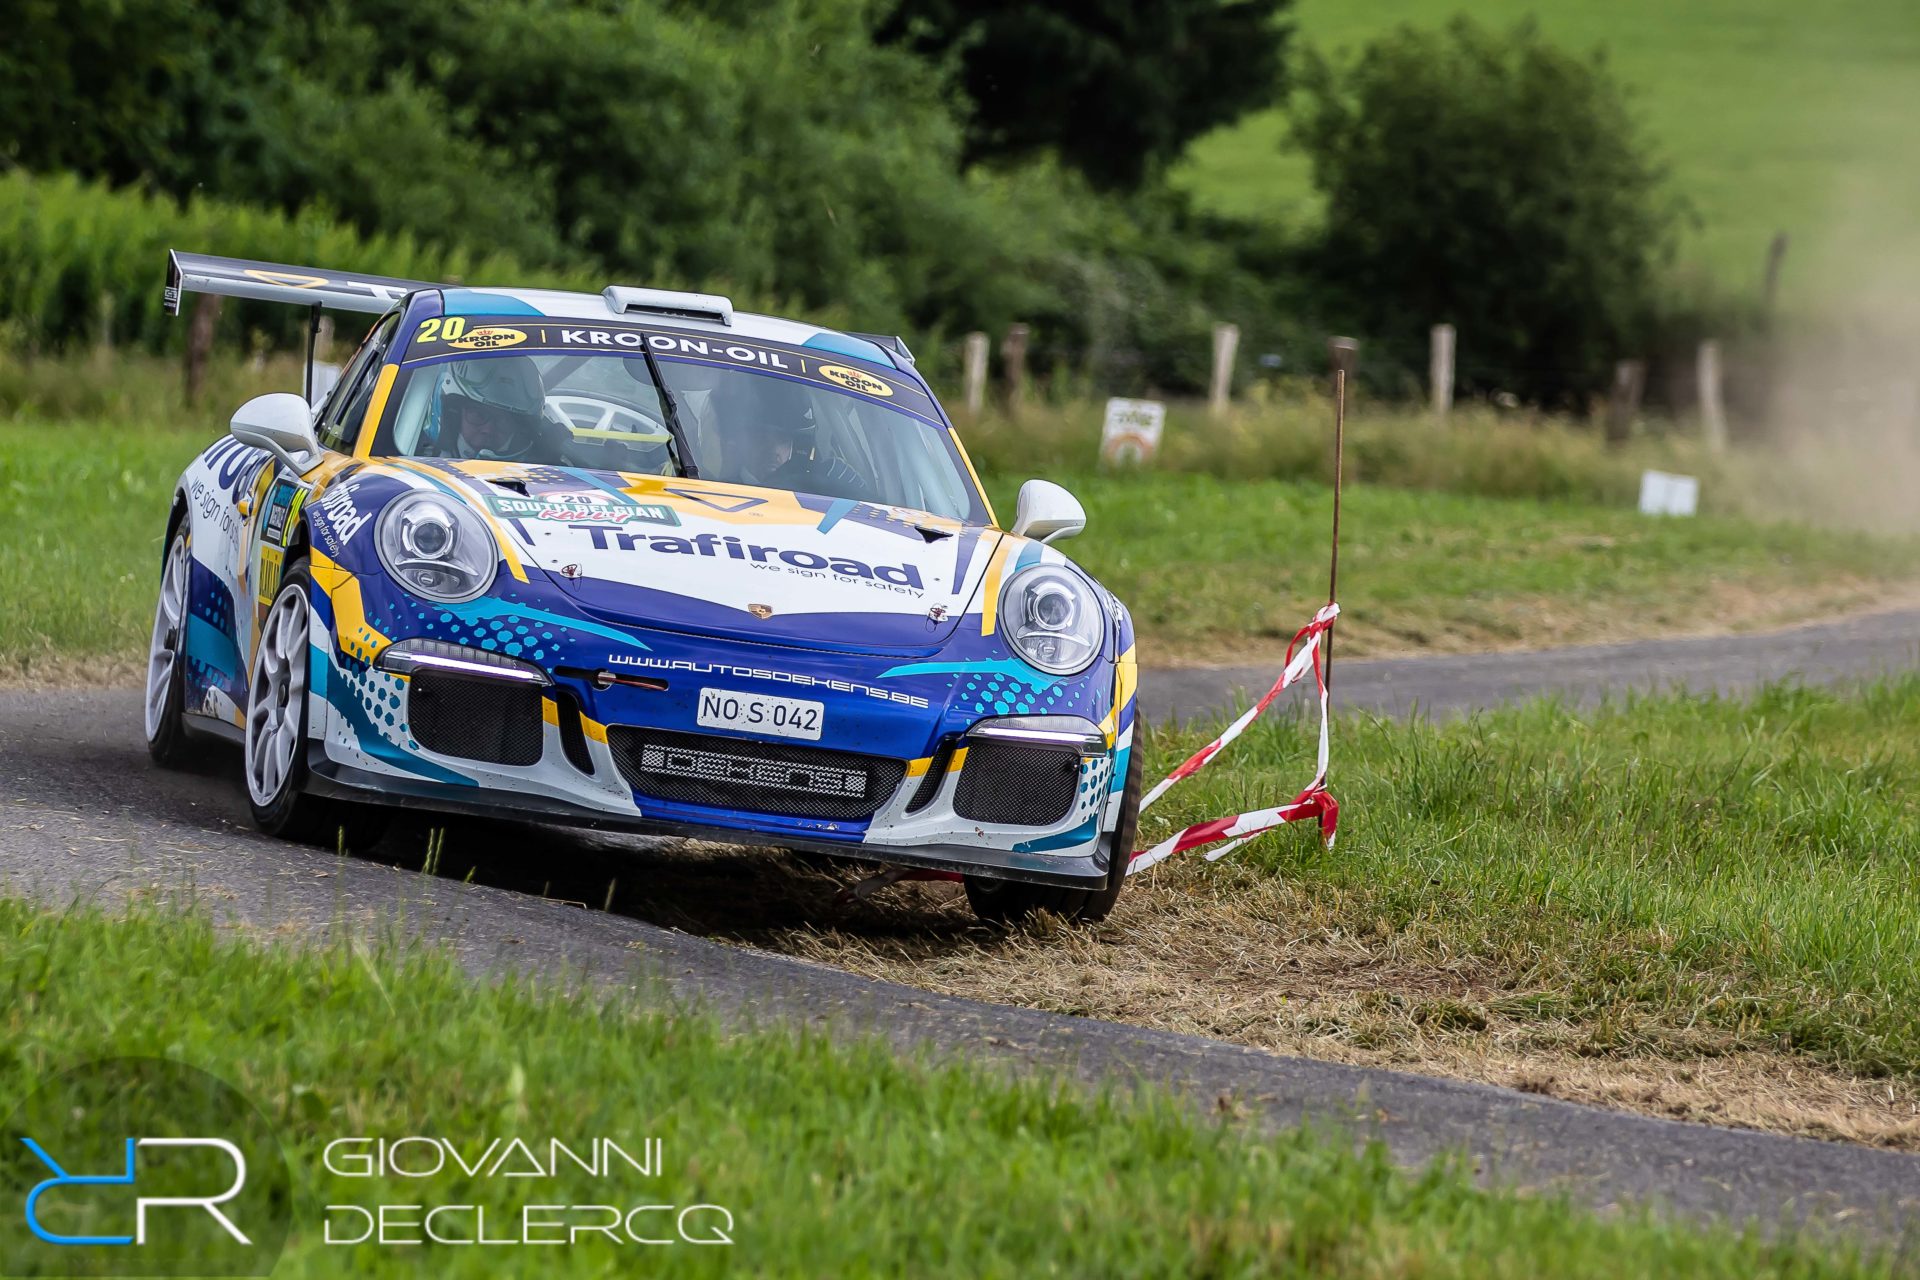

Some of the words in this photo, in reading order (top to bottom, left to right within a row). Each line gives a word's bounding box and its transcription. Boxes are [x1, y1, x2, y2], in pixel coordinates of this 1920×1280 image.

[417, 317, 466, 343] 20
[456, 334, 515, 344] KROON
[474, 340, 500, 348] OIL
[561, 329, 789, 369] KROON-OIL
[829, 369, 883, 391] KROON
[844, 379, 869, 392] OIL
[500, 499, 566, 513] SOUTH
[574, 504, 665, 520] BELGIAN
[561, 494, 593, 504] 20
[568, 523, 925, 590] Trafiroad
[749, 563, 781, 572] we
[787, 566, 827, 579] sign
[833, 573, 859, 584] for
[864, 579, 924, 599] safety
[608, 653, 929, 709] WWW.AUTOSDEKENS.BE
[702, 695, 739, 720] NO
[748, 701, 765, 724] S
[773, 704, 818, 731] 042
